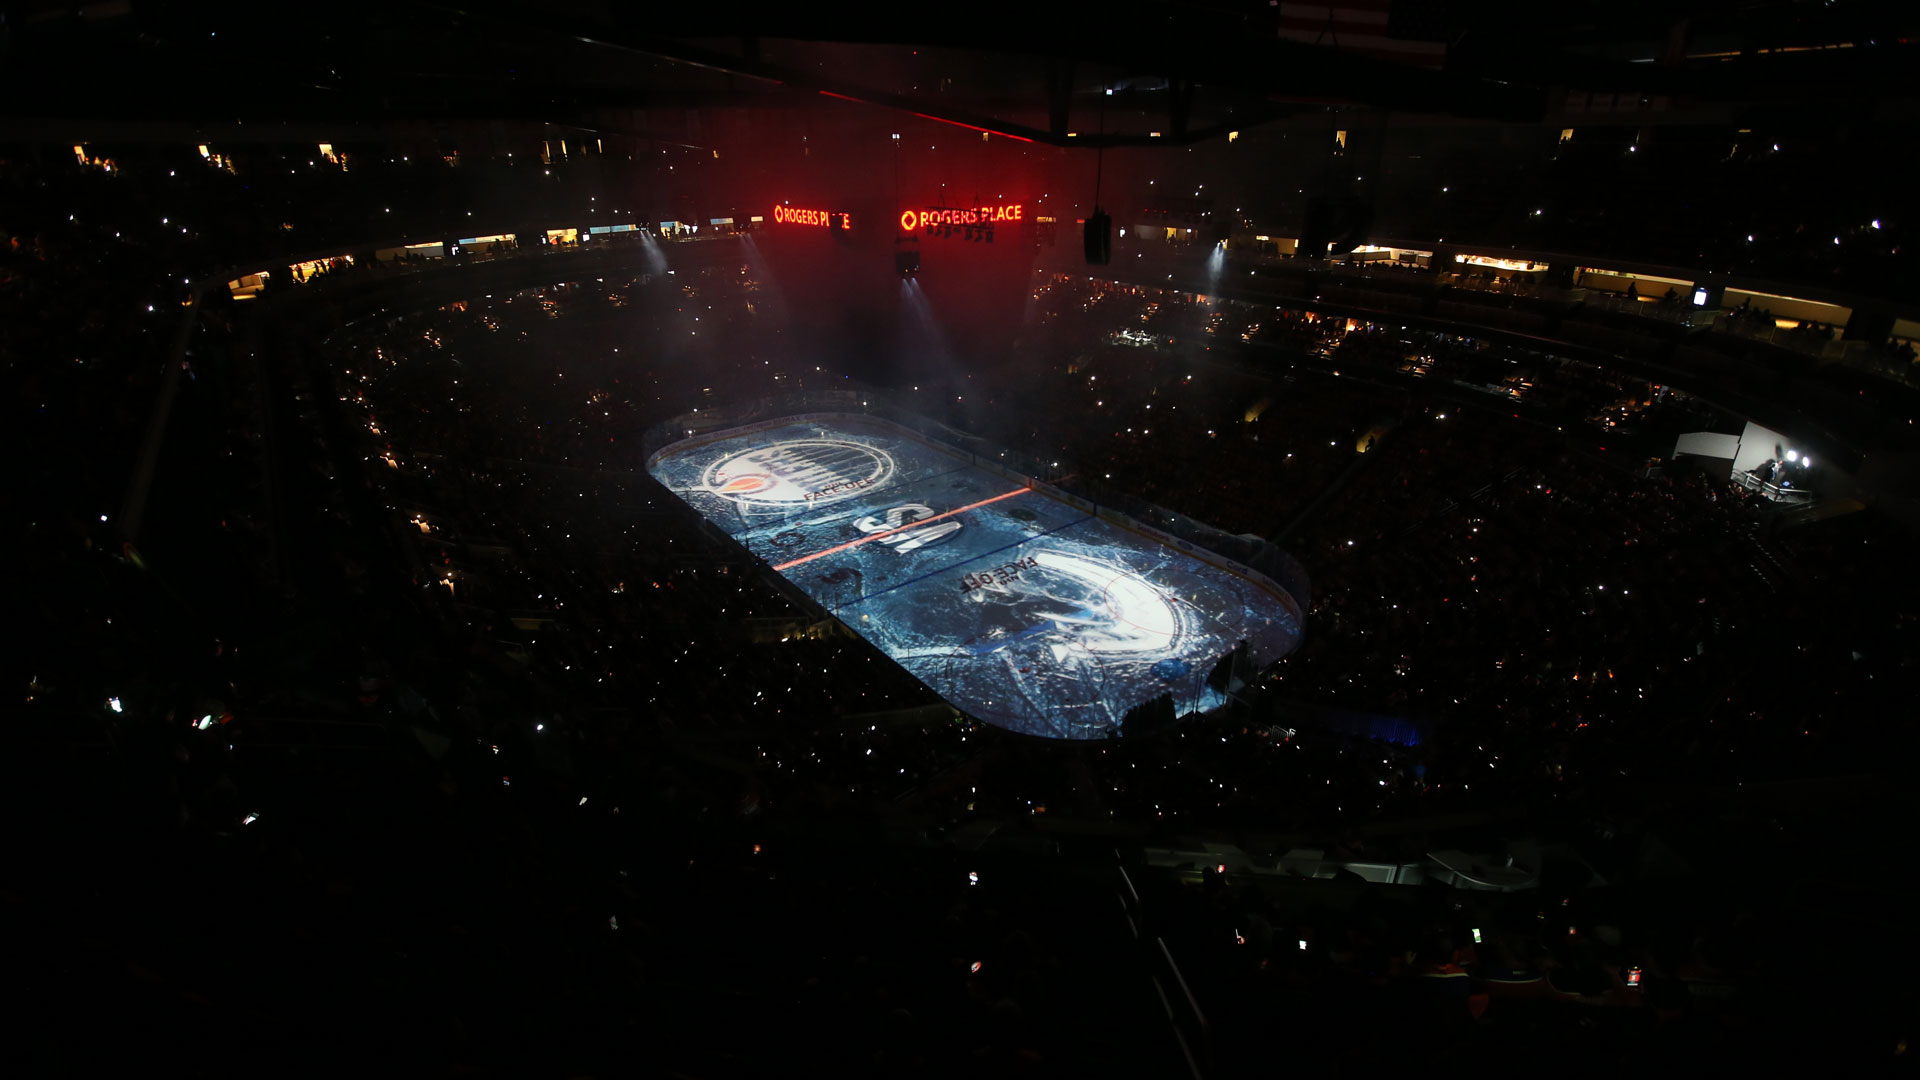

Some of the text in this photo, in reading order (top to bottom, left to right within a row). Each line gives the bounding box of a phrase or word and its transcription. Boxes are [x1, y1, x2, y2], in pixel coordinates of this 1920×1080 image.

[784, 207, 819, 226] ROGERS
[920, 205, 1022, 227] ROGERS PLACE
